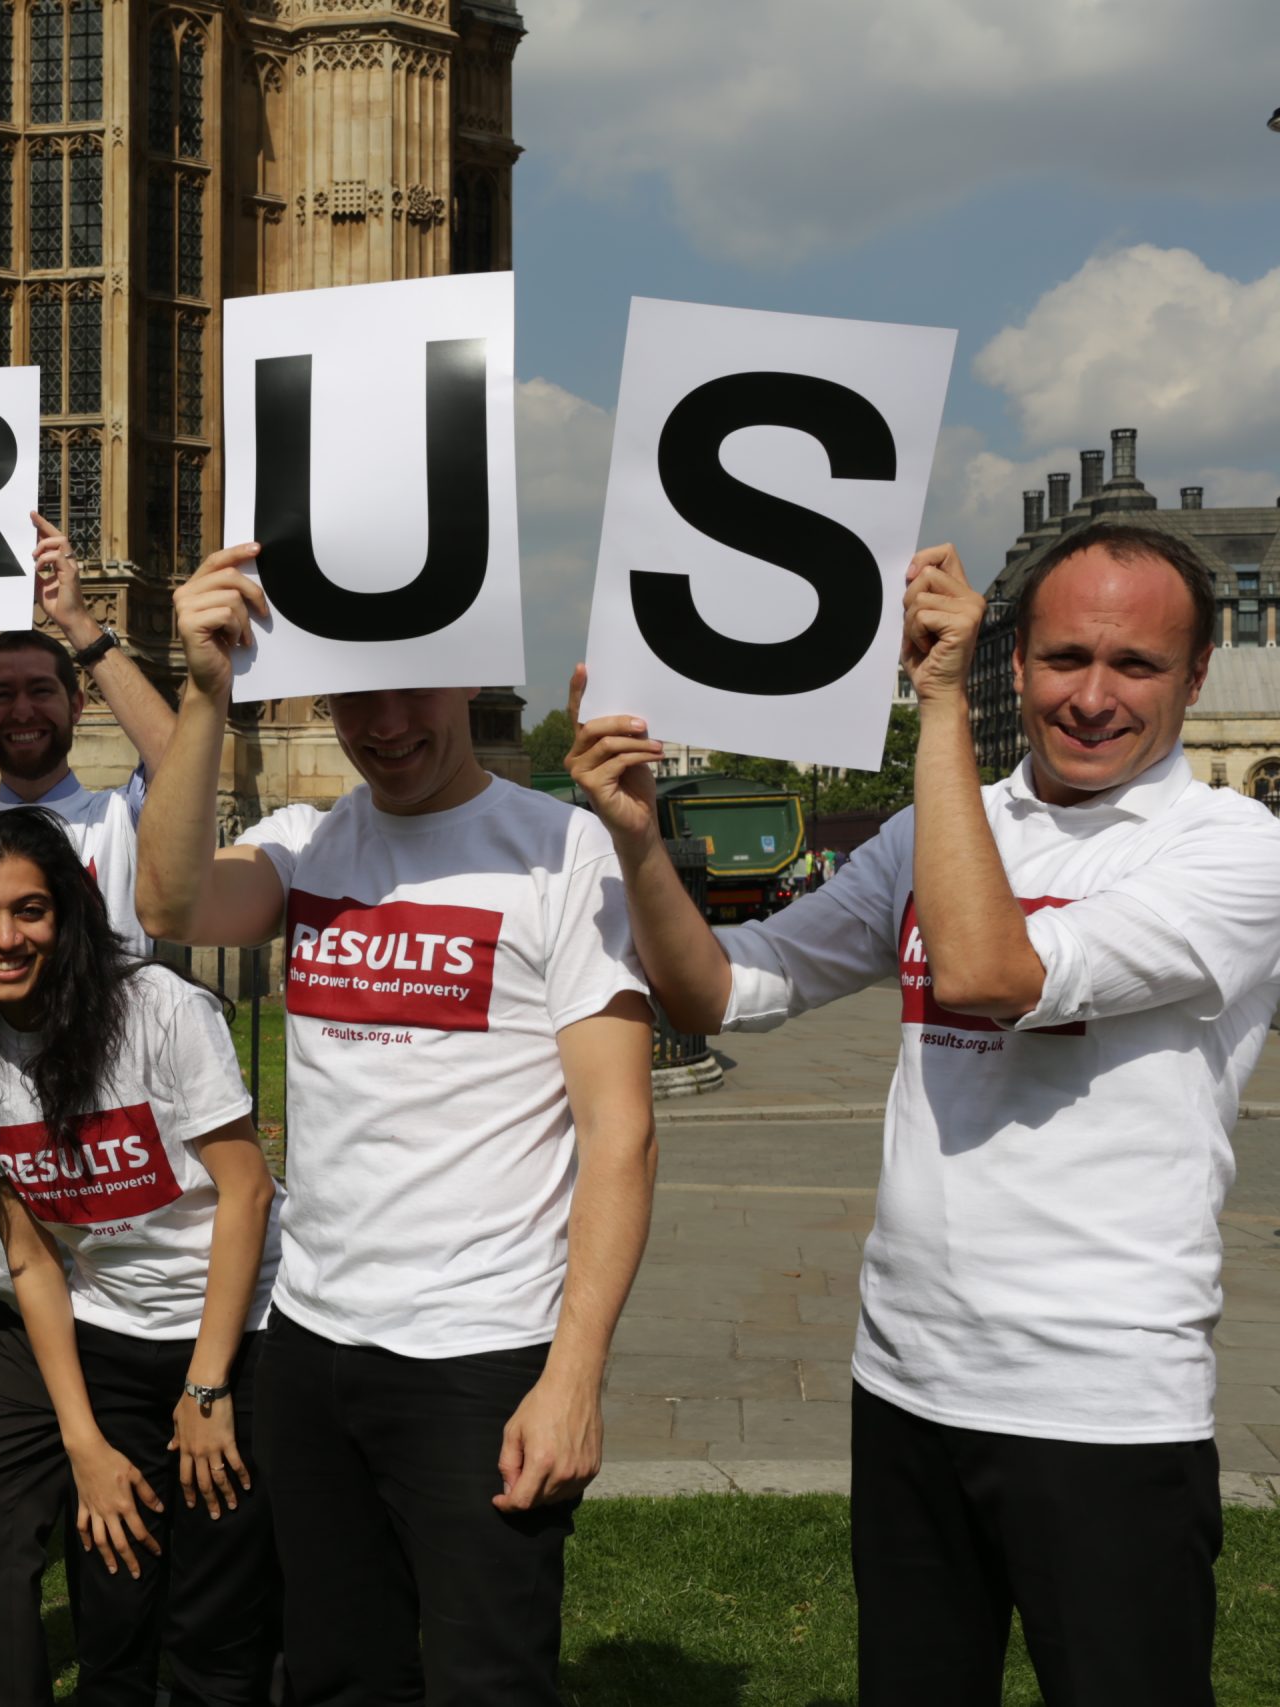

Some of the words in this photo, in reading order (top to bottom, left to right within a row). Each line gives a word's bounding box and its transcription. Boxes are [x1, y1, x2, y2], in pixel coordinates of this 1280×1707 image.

[291, 922, 475, 975] RESULTS
[290, 967, 306, 983] the
[308, 972, 351, 988] power
[352, 976, 369, 990] to
[372, 978, 400, 992] end
[402, 981, 470, 1001] poverty
[321, 1026, 413, 1045] results.org.uk
[920, 1032, 1004, 1054] results.org.uk
[28, 1188, 62, 1201] power
[65, 1186, 78, 1198] to
[80, 1181, 104, 1197] end
[105, 1171, 158, 1195] poverty
